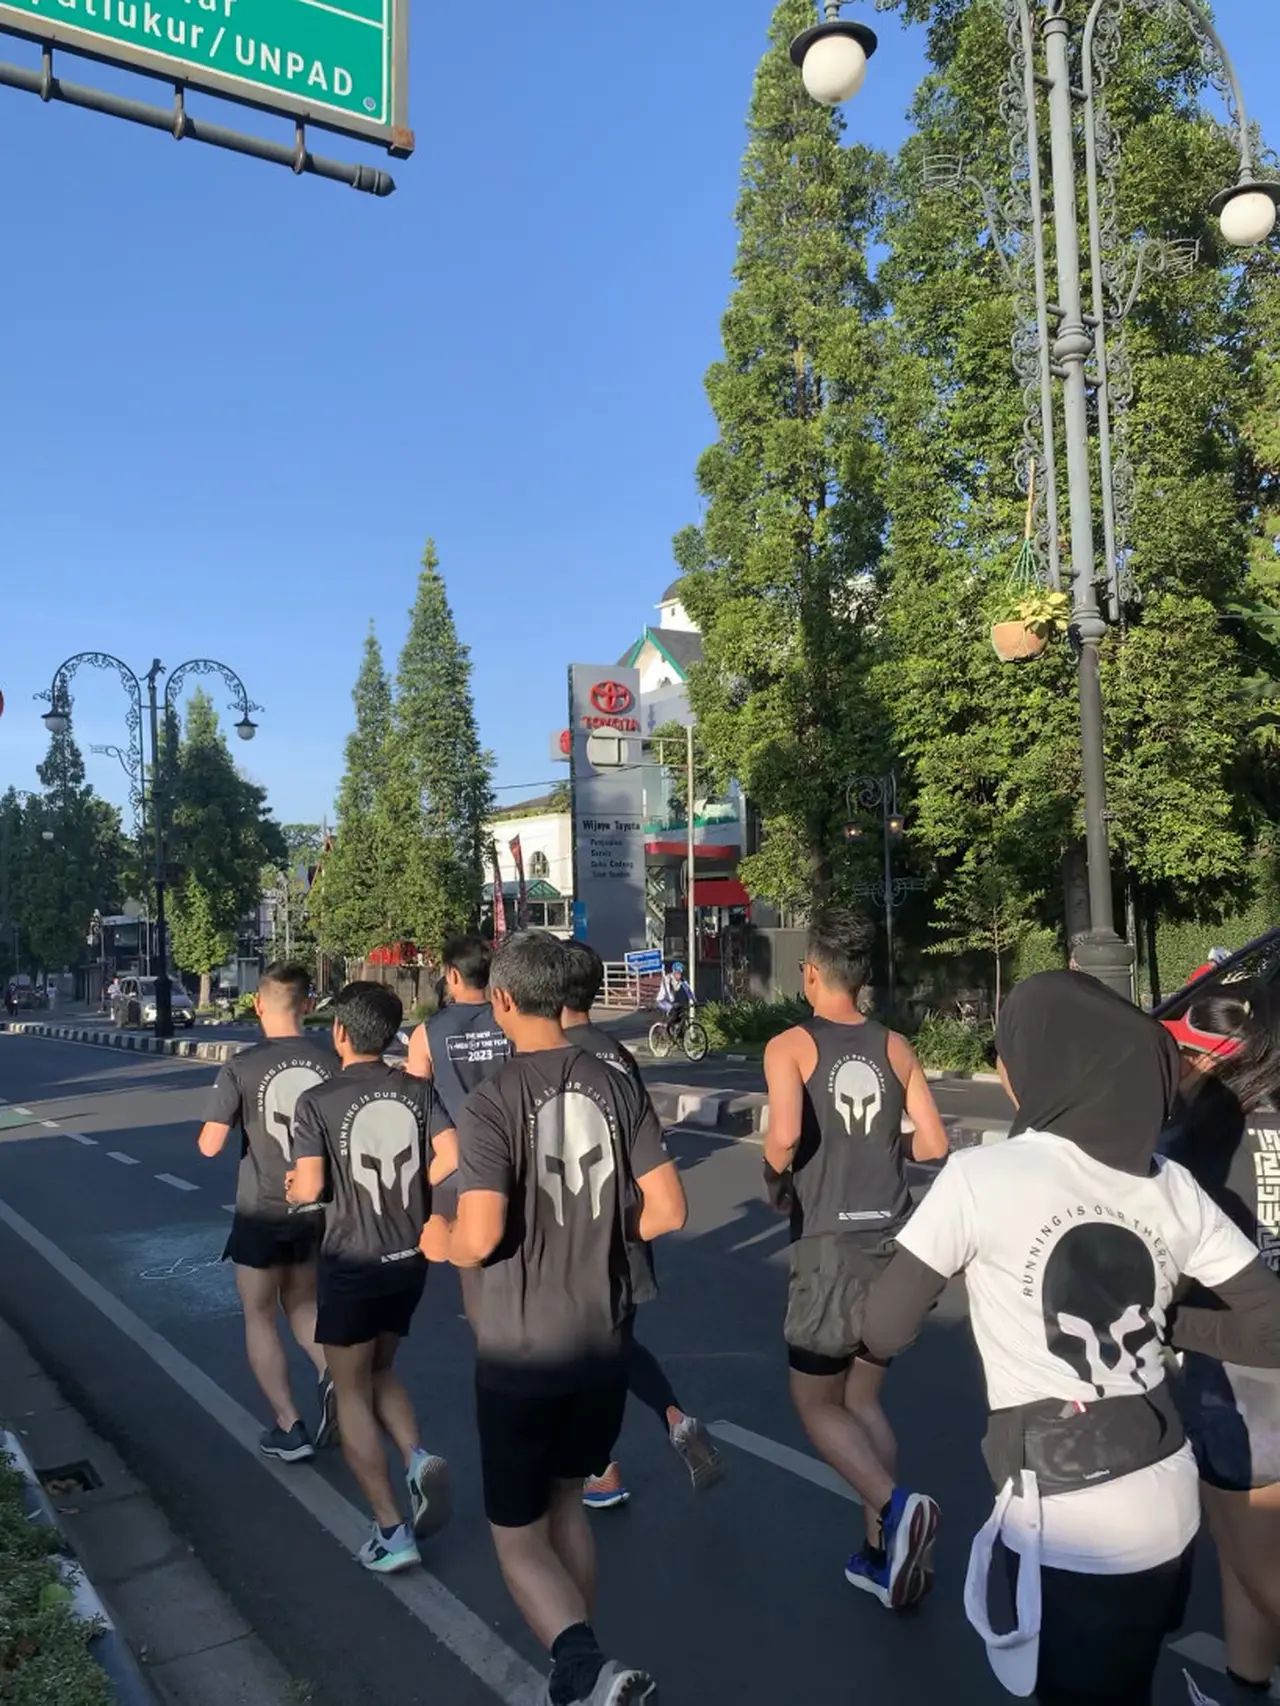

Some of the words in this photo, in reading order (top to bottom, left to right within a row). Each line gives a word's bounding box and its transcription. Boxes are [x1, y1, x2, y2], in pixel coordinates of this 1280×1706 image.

[235, 34, 354, 97] UNPAD
[582, 716, 639, 731] TOYOTA
[468, 1050, 493, 1062] 2023
[291, 1059, 312, 1067] OUR
[359, 1094, 370, 1104] IS
[1023, 1215, 1062, 1297] RUNNING
[1066, 1205, 1085, 1218] IS
[1094, 1204, 1125, 1221] OUR
